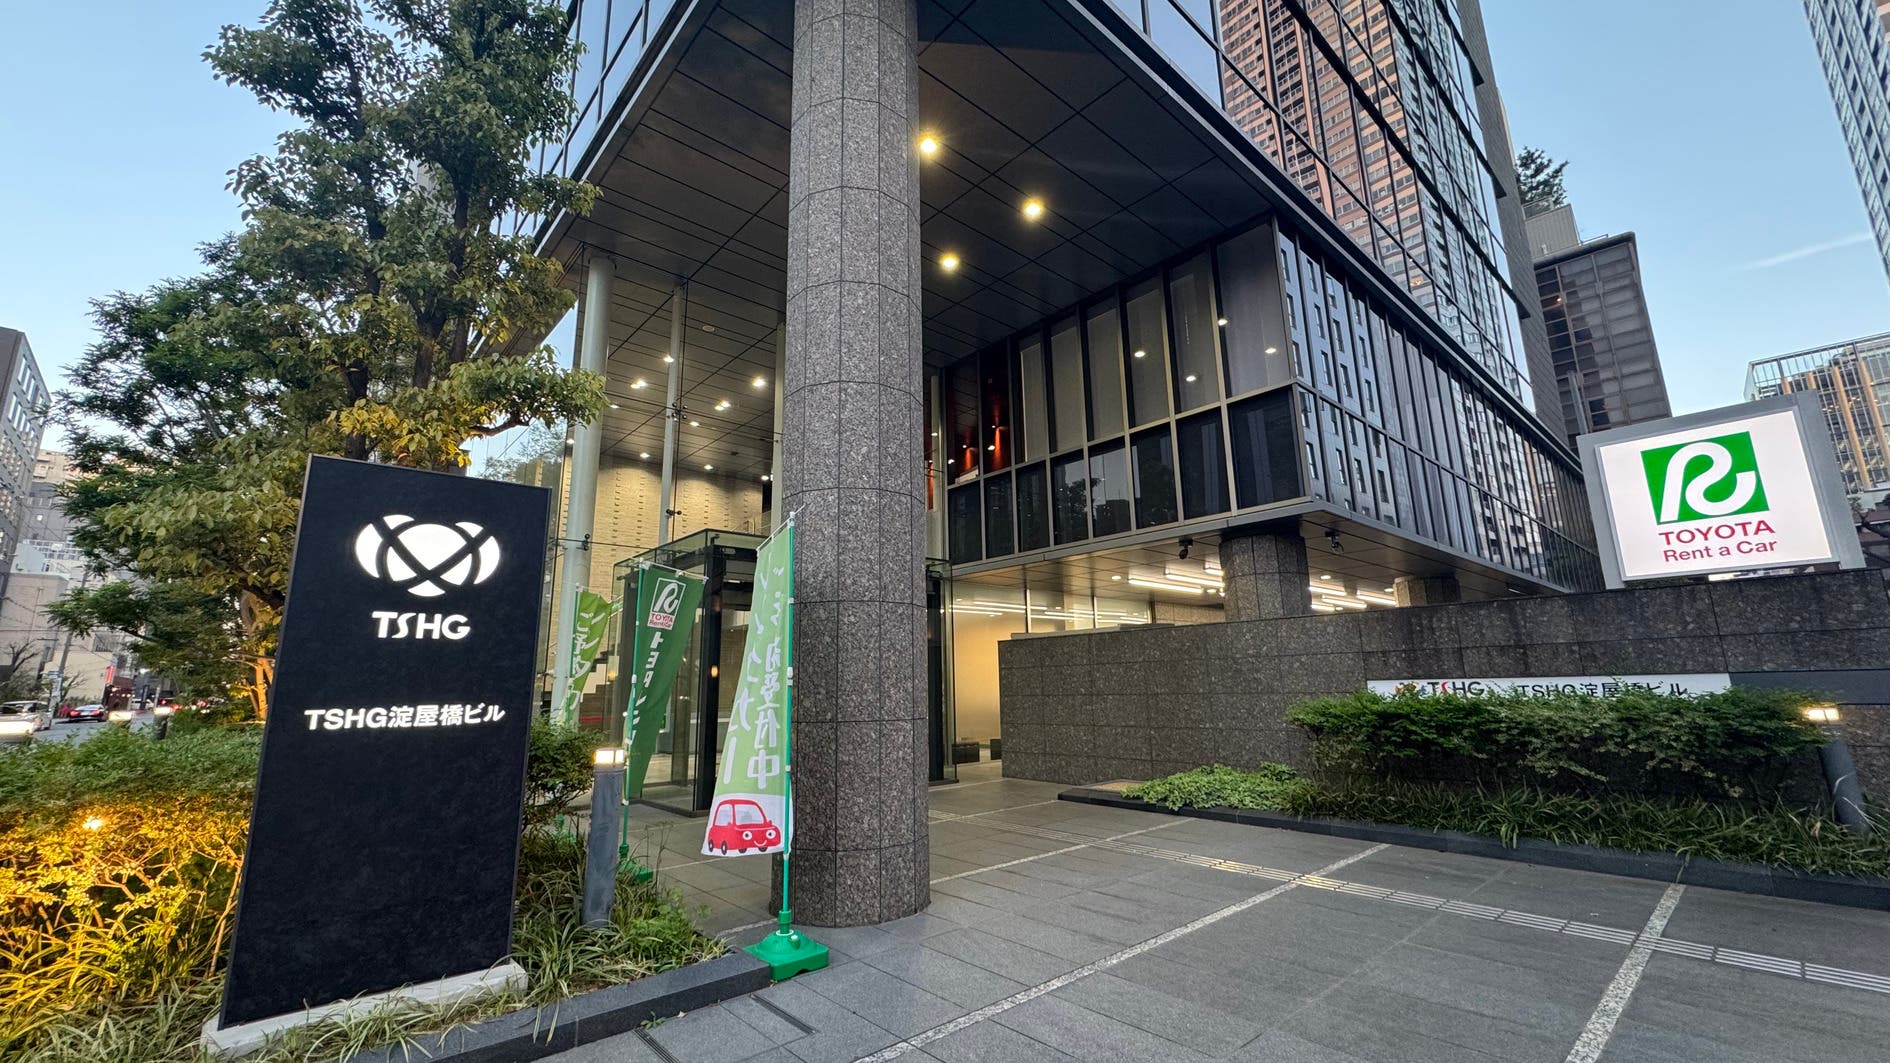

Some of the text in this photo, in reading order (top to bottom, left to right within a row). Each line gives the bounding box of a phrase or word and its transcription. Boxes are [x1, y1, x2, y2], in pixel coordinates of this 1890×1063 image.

[1658, 519, 1776, 546] TOYOTA
[1663, 540, 1778, 562] Rent a Car
[371, 611, 472, 640] TSHG
[303, 702, 506, 731] TSHG淀屋橋ビル
